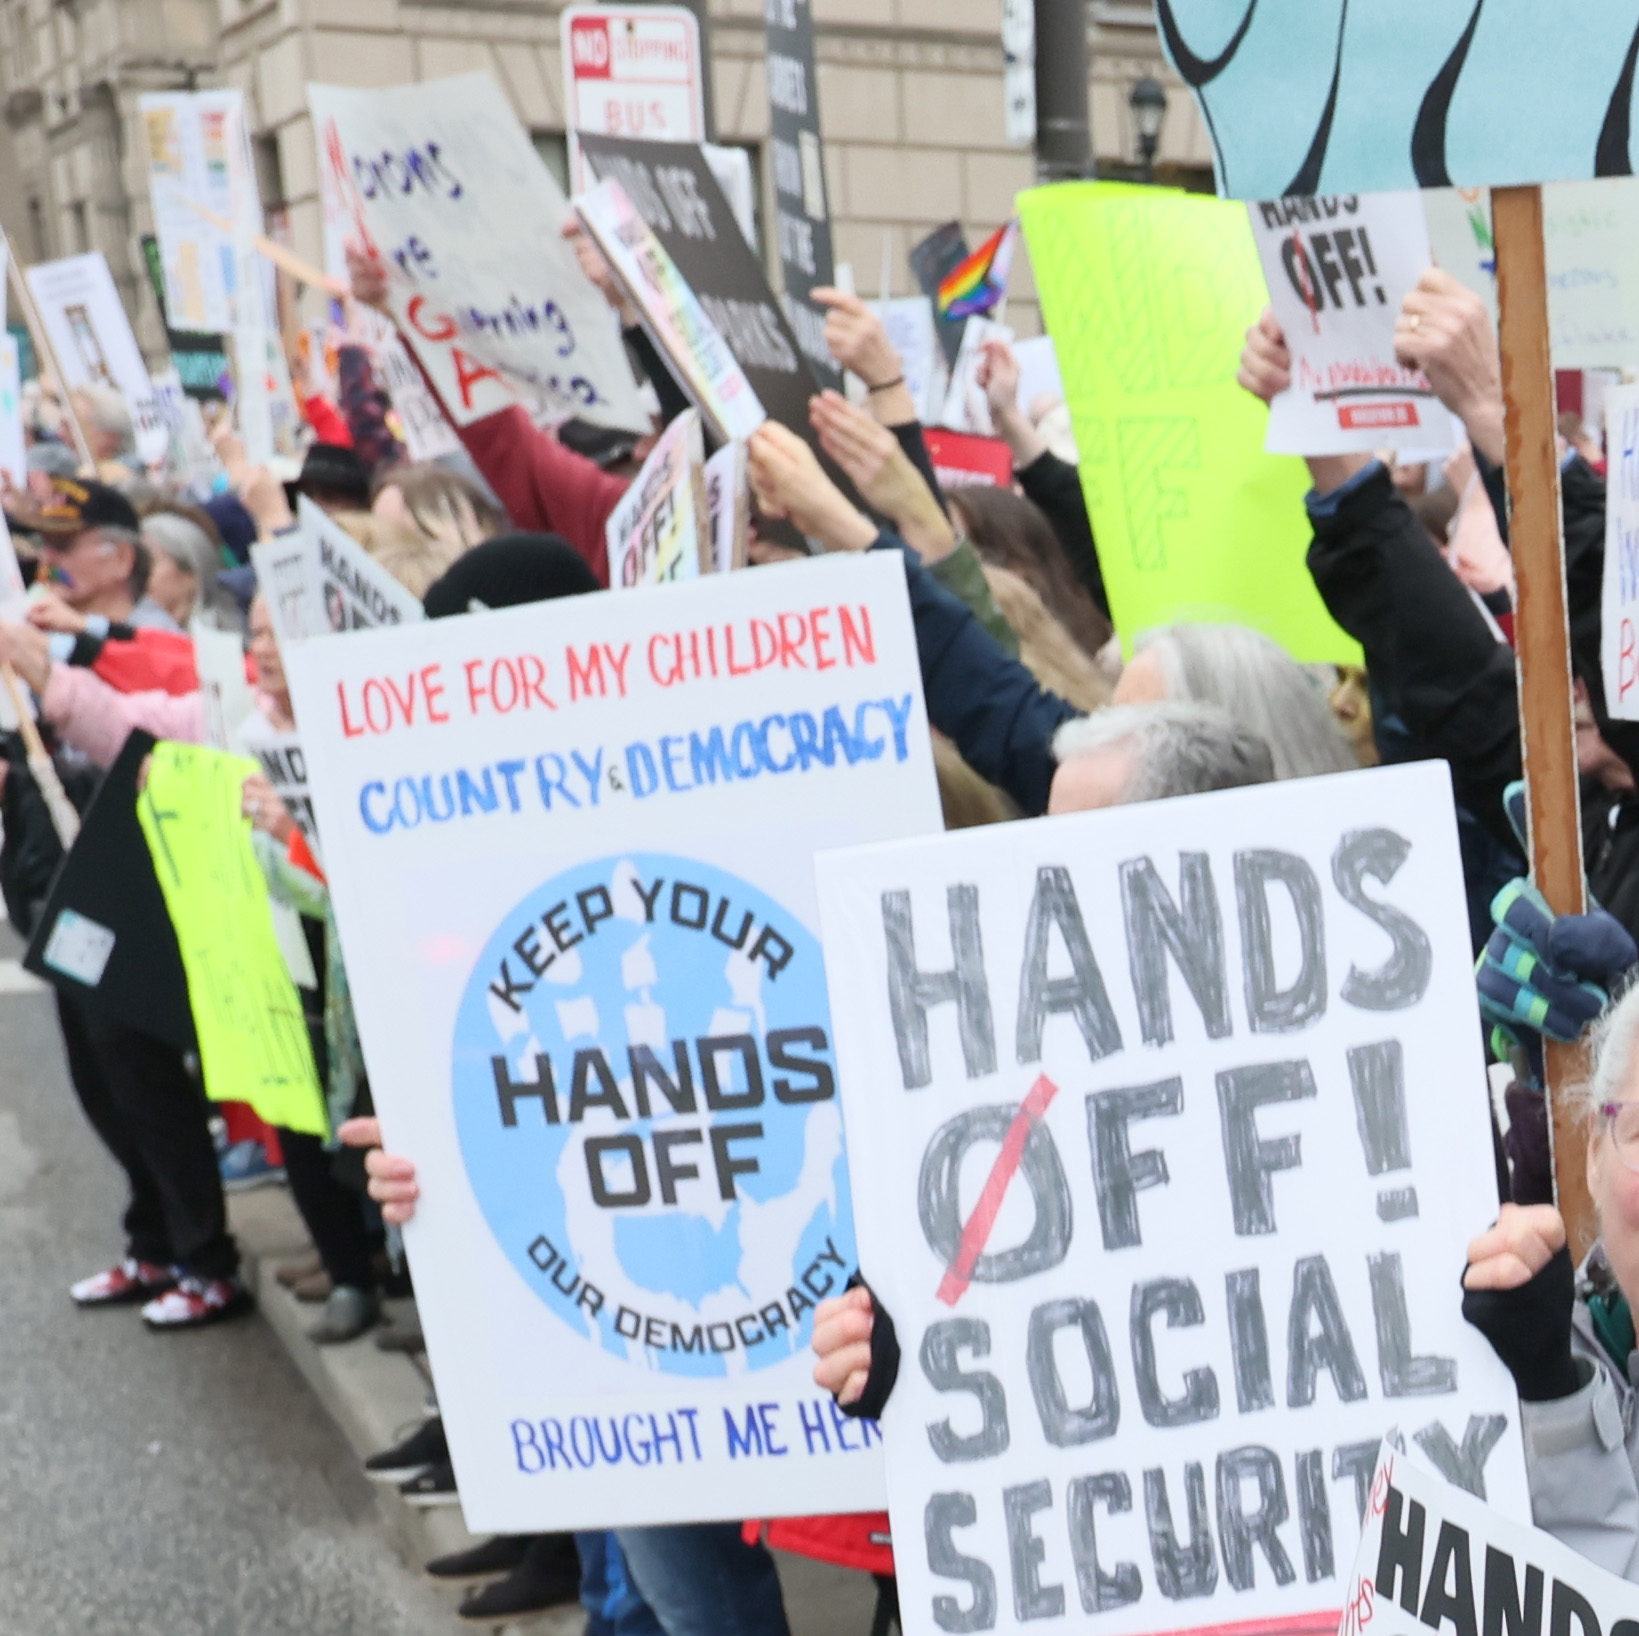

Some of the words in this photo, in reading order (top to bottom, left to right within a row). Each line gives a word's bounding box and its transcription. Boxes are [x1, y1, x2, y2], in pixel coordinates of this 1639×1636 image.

[605, 98, 668, 132] BUS
[1280, 225, 1387, 313] OFF!
[336, 662, 450, 740] LOVE
[465, 654, 558, 718] FOR
[565, 640, 632, 703] MY
[647, 604, 877, 689] CHILDREN
[357, 746, 609, 836] COUNTRY
[624, 692, 915, 799] DEMOCRACY
[489, 882, 617, 1014] KEEP
[631, 876, 795, 982] YOUR
[880, 826, 1433, 1091] HANDS
[490, 1024, 836, 1130] HANDS
[583, 1121, 765, 1211] OFF
[917, 1039, 1420, 1292] OFF!
[526, 1233, 605, 1319] OUR
[612, 1235, 848, 1358] DEMOCRACY
[918, 1251, 1459, 1467] SOCIAL
[509, 1408, 702, 1475] BROUGHT
[725, 1401, 789, 1462] ME
[797, 1398, 883, 1457] HER
